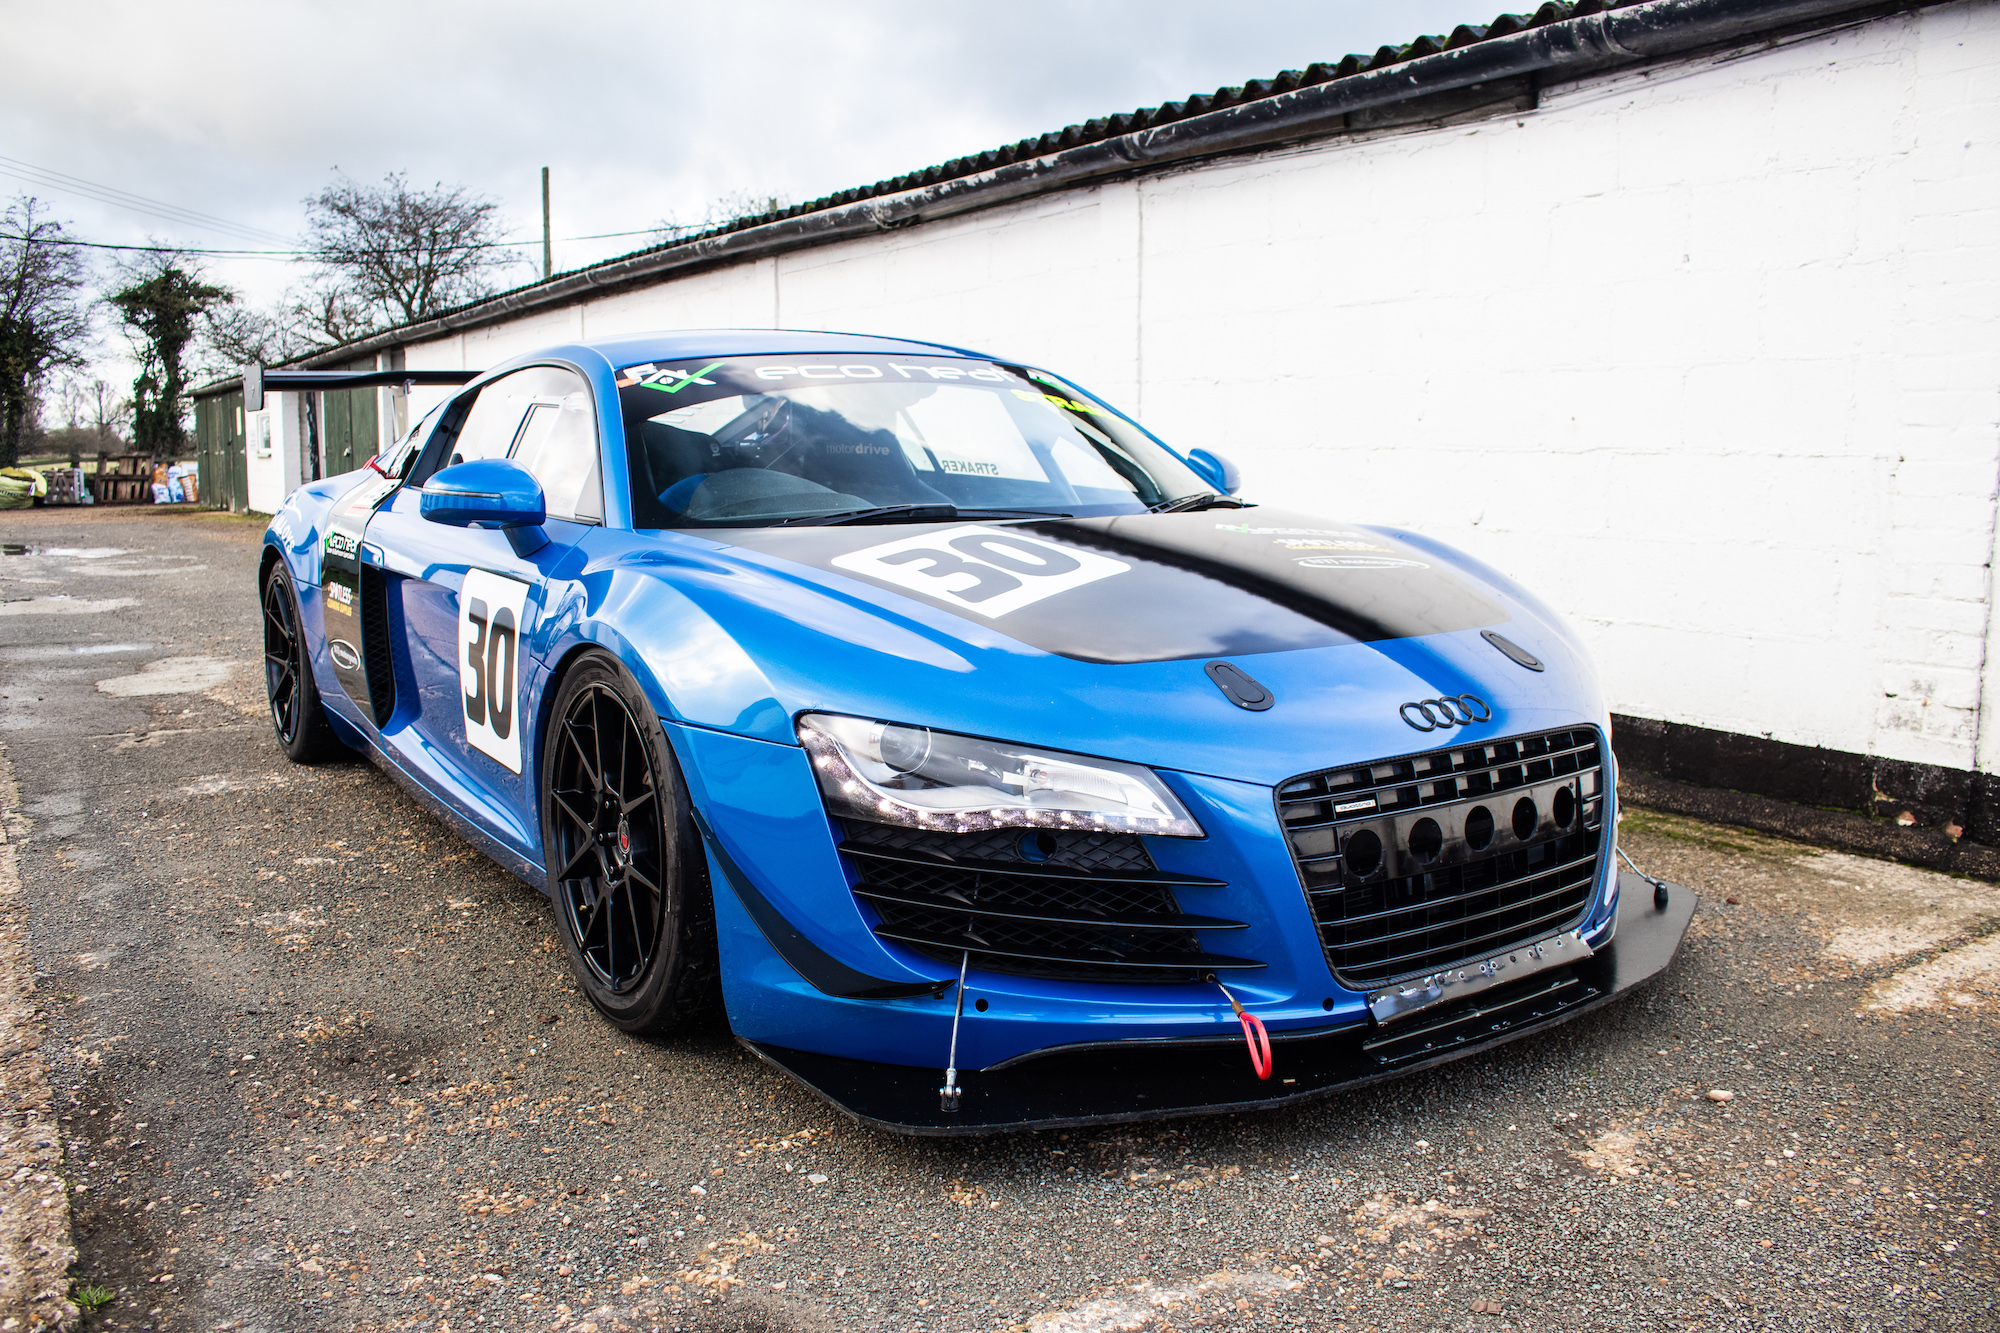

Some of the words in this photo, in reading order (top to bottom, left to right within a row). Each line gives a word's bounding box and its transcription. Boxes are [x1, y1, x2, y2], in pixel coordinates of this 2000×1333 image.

[755, 364, 884, 380] eco
[888, 362, 1016, 383] heat
[826, 443, 890, 456] motordrive
[876, 533, 1082, 604] 30
[465, 596, 515, 740] 30
[1340, 801, 1372, 811] quattro
